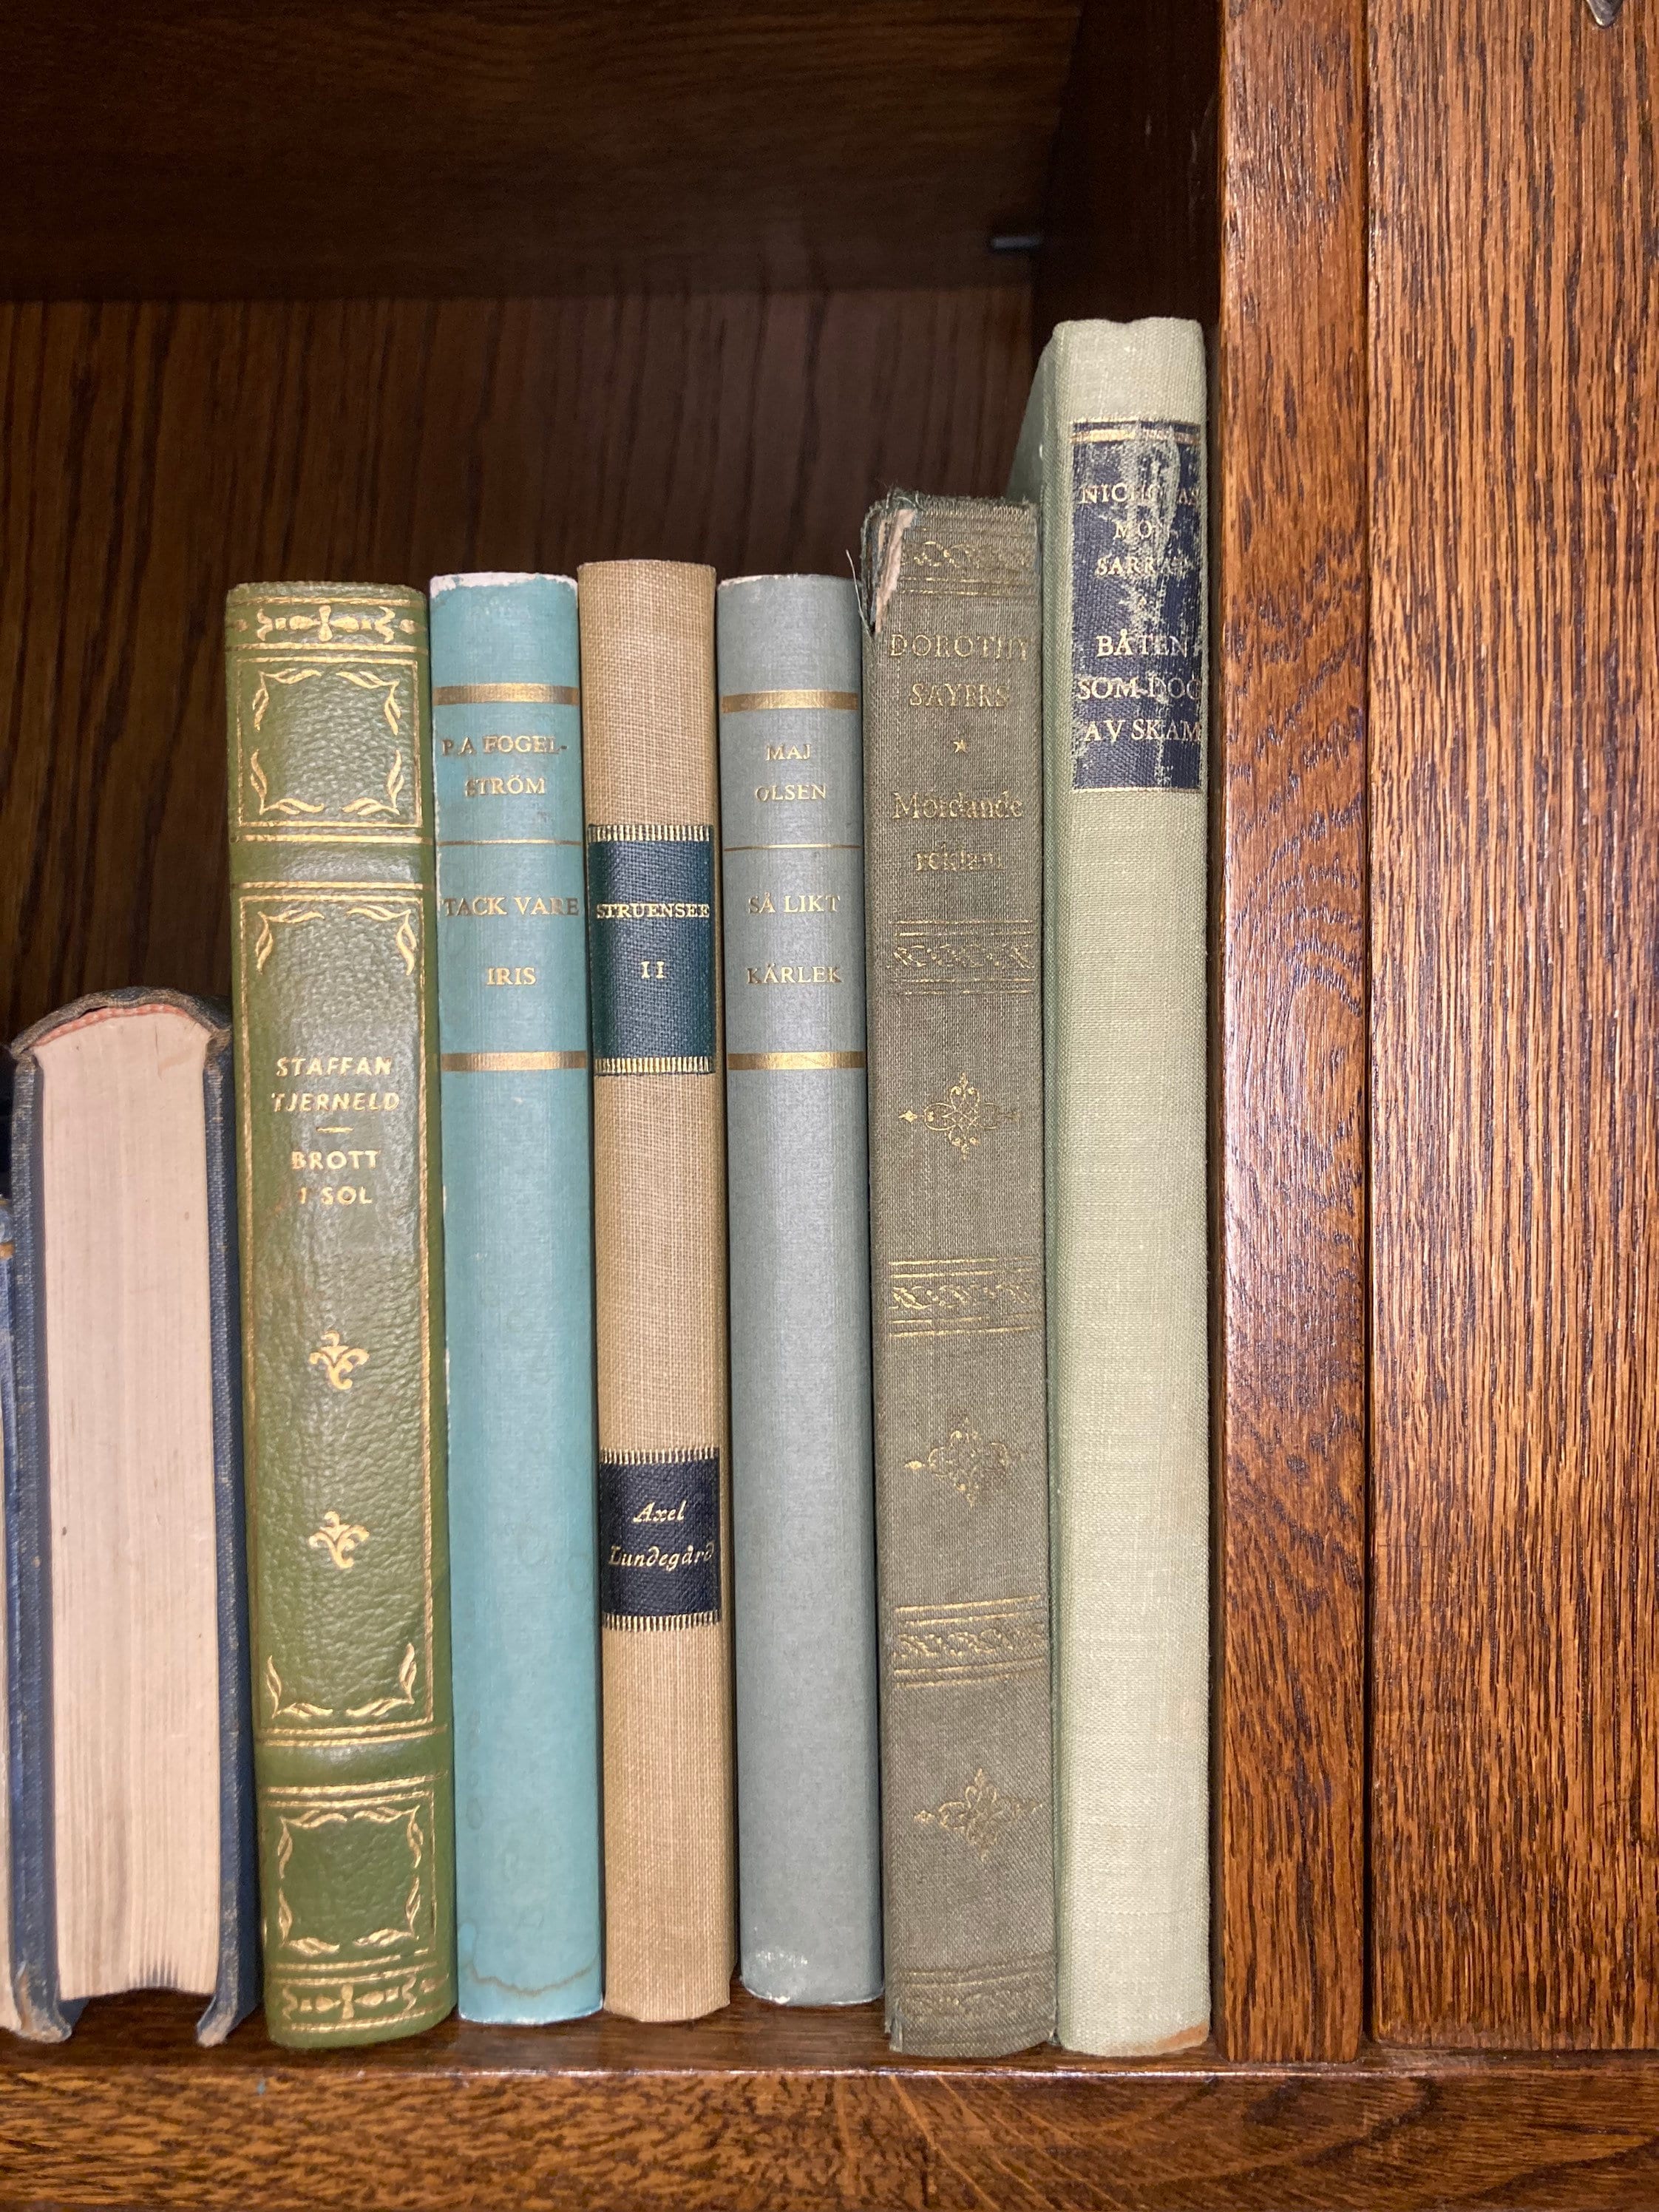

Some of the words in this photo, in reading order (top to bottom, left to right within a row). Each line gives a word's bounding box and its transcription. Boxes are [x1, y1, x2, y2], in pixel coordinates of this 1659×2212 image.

[889, 634, 1031, 661] DOROTHY
[1096, 628, 1188, 658] BÅTEN
[910, 683, 1010, 708] SAYERS
[1078, 676, 1141, 700] SOM
[1131, 719, 1202, 742] SKAM
[483, 735, 568, 755] FOGEL-
[765, 743, 812, 761] MAJ
[465, 775, 546, 798] STRÖM
[755, 782, 827, 802] OLSEN
[442, 896, 508, 917] TACK
[513, 895, 580, 917] VARE
[597, 902, 710, 919] STRUENSEE
[747, 892, 776, 915] SÅ
[783, 894, 841, 914] LIKT
[486, 966, 537, 986] IRIS
[640, 960, 665, 980] II
[747, 962, 843, 985] KÄRLEK
[276, 1056, 393, 1077] STAFFAN
[271, 1091, 400, 1113] TJERNELD
[291, 1150, 381, 1170] BROTT
[321, 1185, 373, 1206] SOL
[632, 1500, 688, 1523] Axel
[608, 1539, 715, 1571] Lundegård
